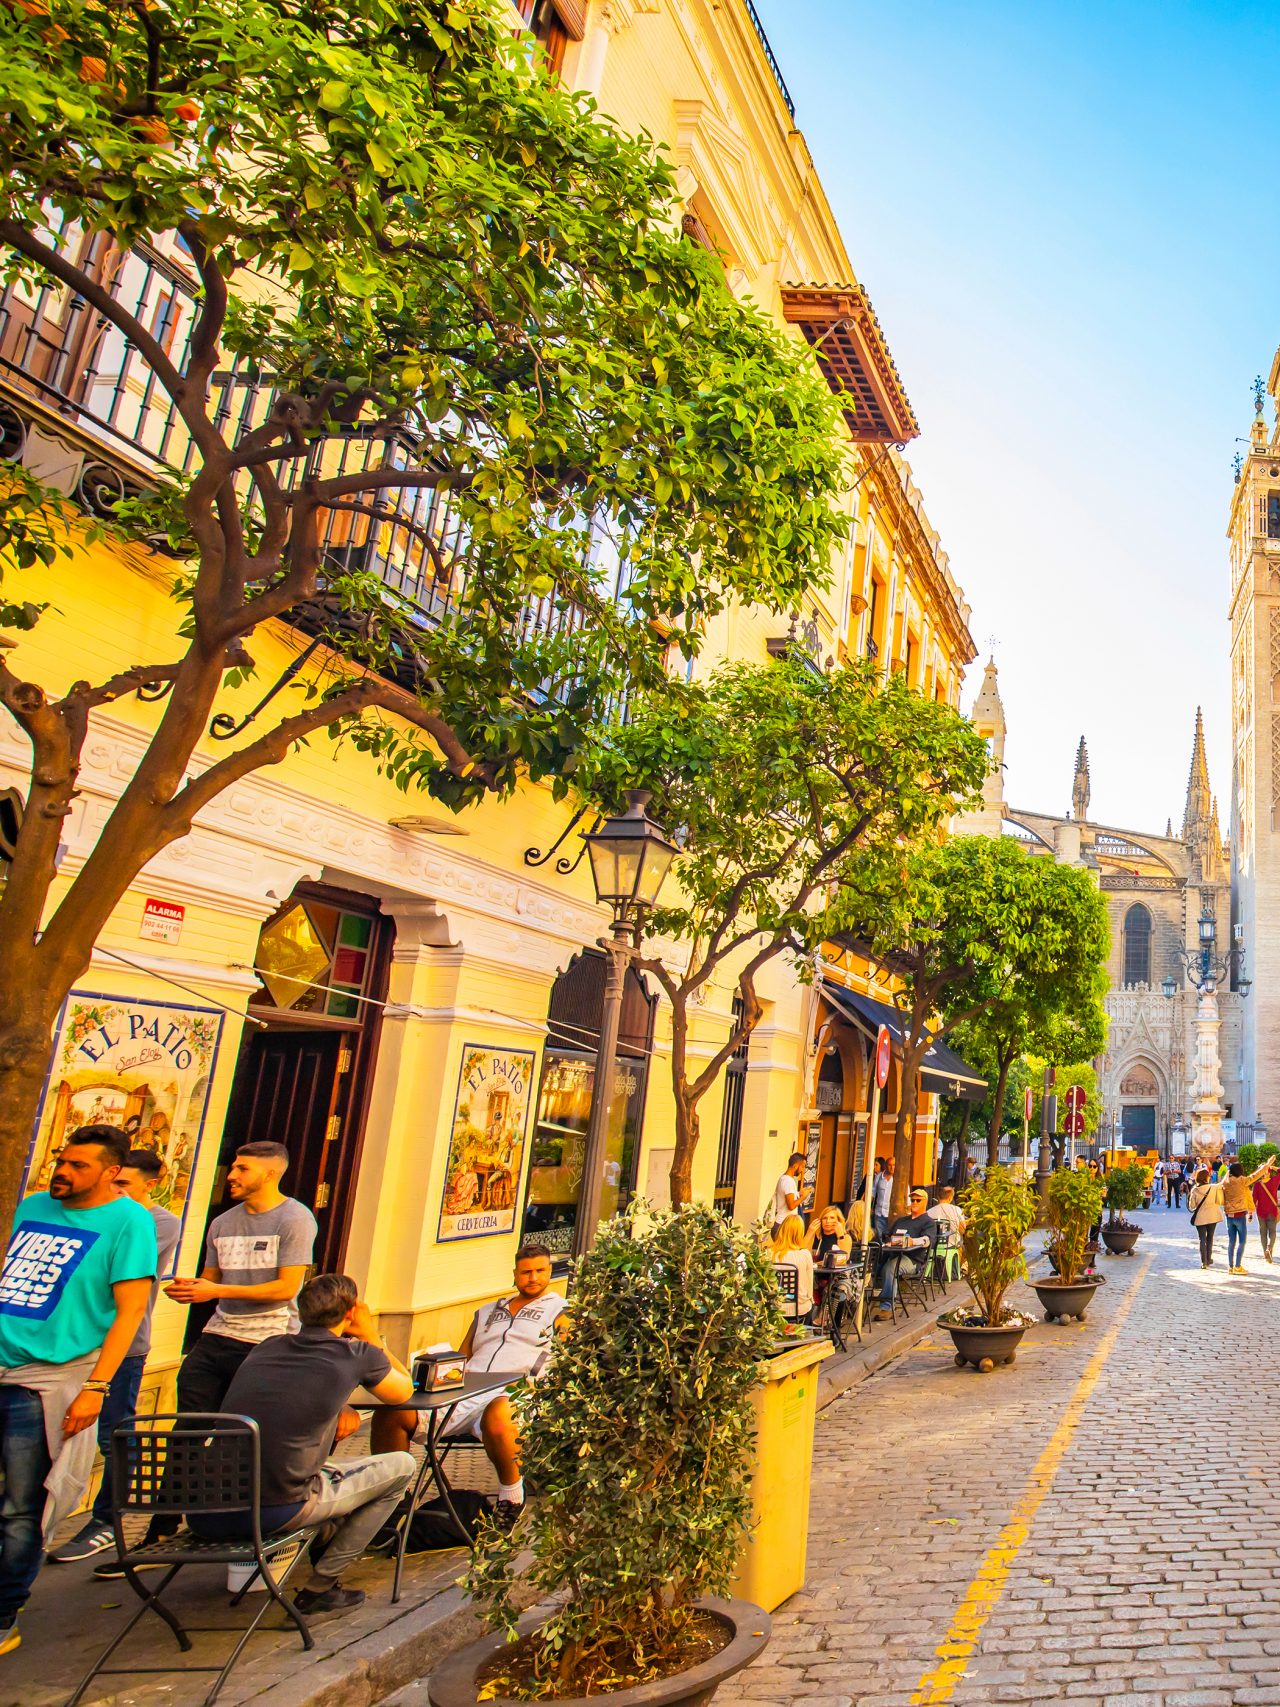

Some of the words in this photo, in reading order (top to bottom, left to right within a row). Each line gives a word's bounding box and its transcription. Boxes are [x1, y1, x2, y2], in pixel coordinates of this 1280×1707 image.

[146, 904, 182, 919] ALARMA
[79, 1025, 121, 1063] EL
[128, 1014, 192, 1070] PATIO
[115, 1055, 137, 1072] San
[468, 1066, 487, 1092] EL
[492, 1058, 523, 1095] PATIO
[7, 1230, 83, 1266] VIBES
